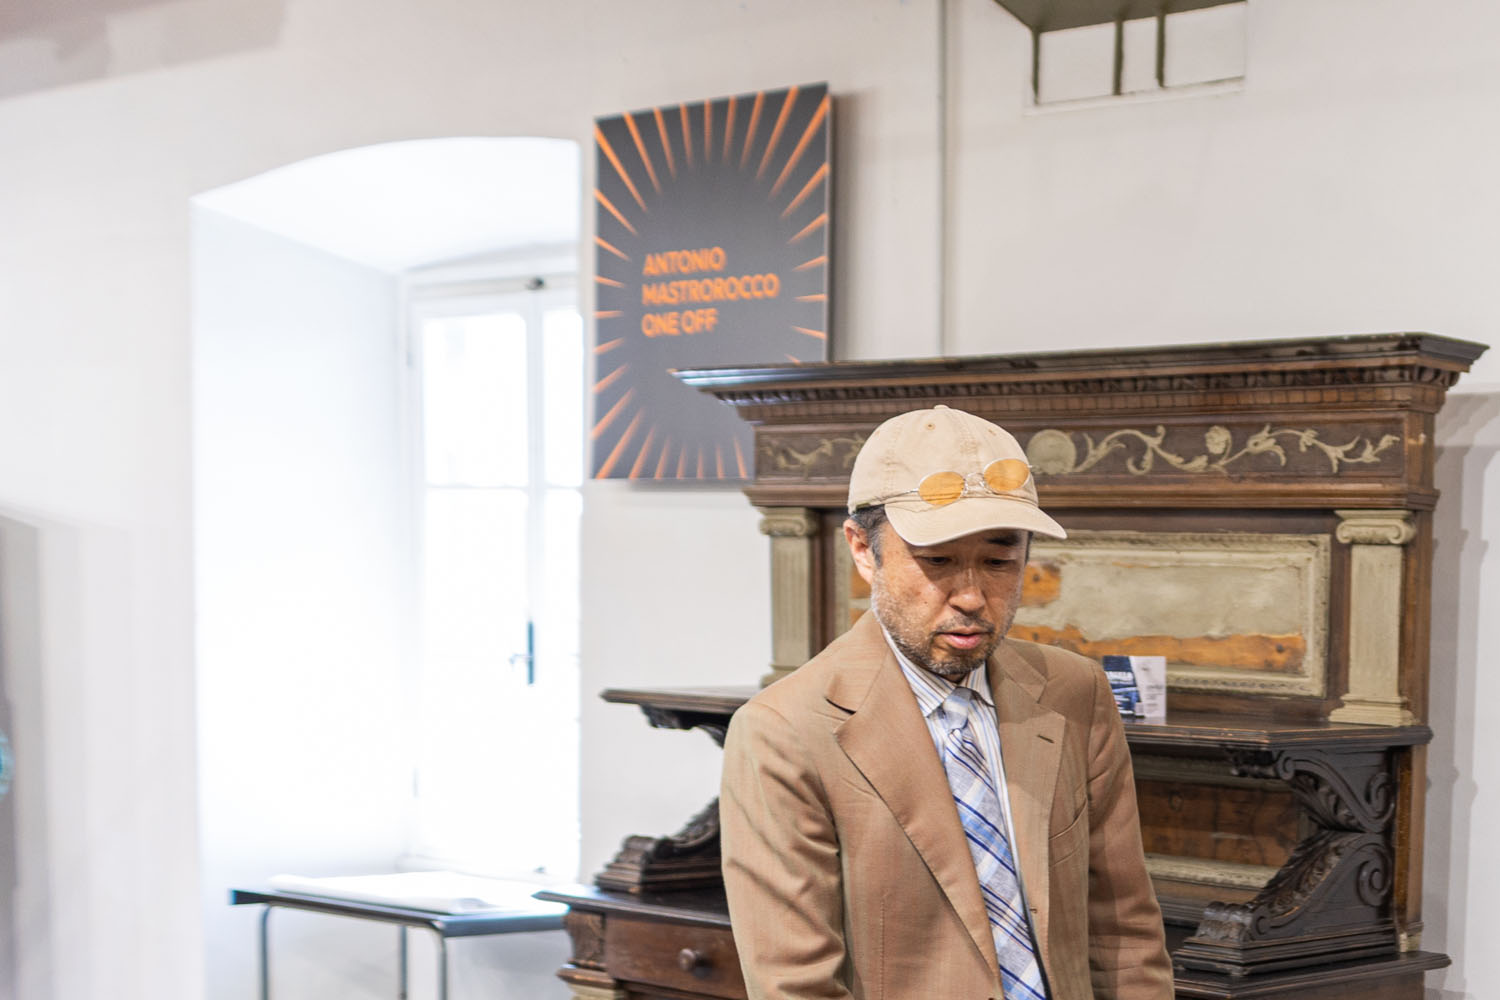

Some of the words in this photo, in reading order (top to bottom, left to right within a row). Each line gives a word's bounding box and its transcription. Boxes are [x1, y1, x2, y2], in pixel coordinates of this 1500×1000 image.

[643, 246, 727, 276] ANTONIO
[641, 273, 781, 306] MASTROROCCO
[641, 311, 681, 338] ONE
[681, 307, 718, 335] OFF
